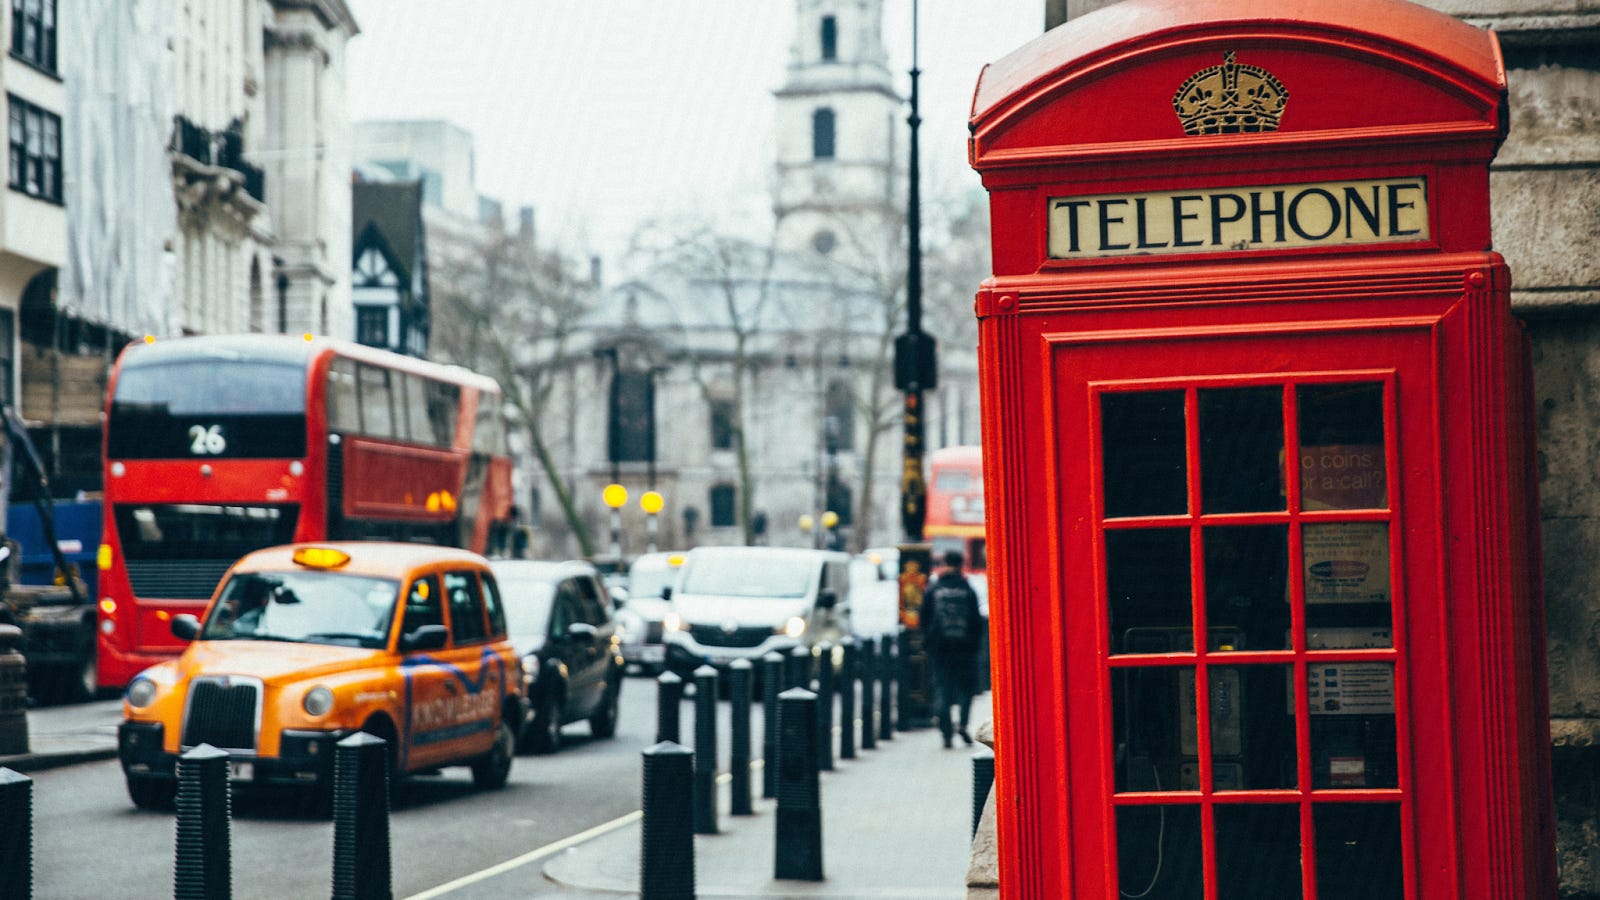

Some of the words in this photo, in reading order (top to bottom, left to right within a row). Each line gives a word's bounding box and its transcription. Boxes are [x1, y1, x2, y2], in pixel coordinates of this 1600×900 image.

[1055, 183, 1422, 253] TELEPHONE
[189, 424, 226, 455] 26
[1320, 454, 1372, 469] coins
[1322, 475, 1333, 489] a
[1341, 470, 1383, 489] call?
